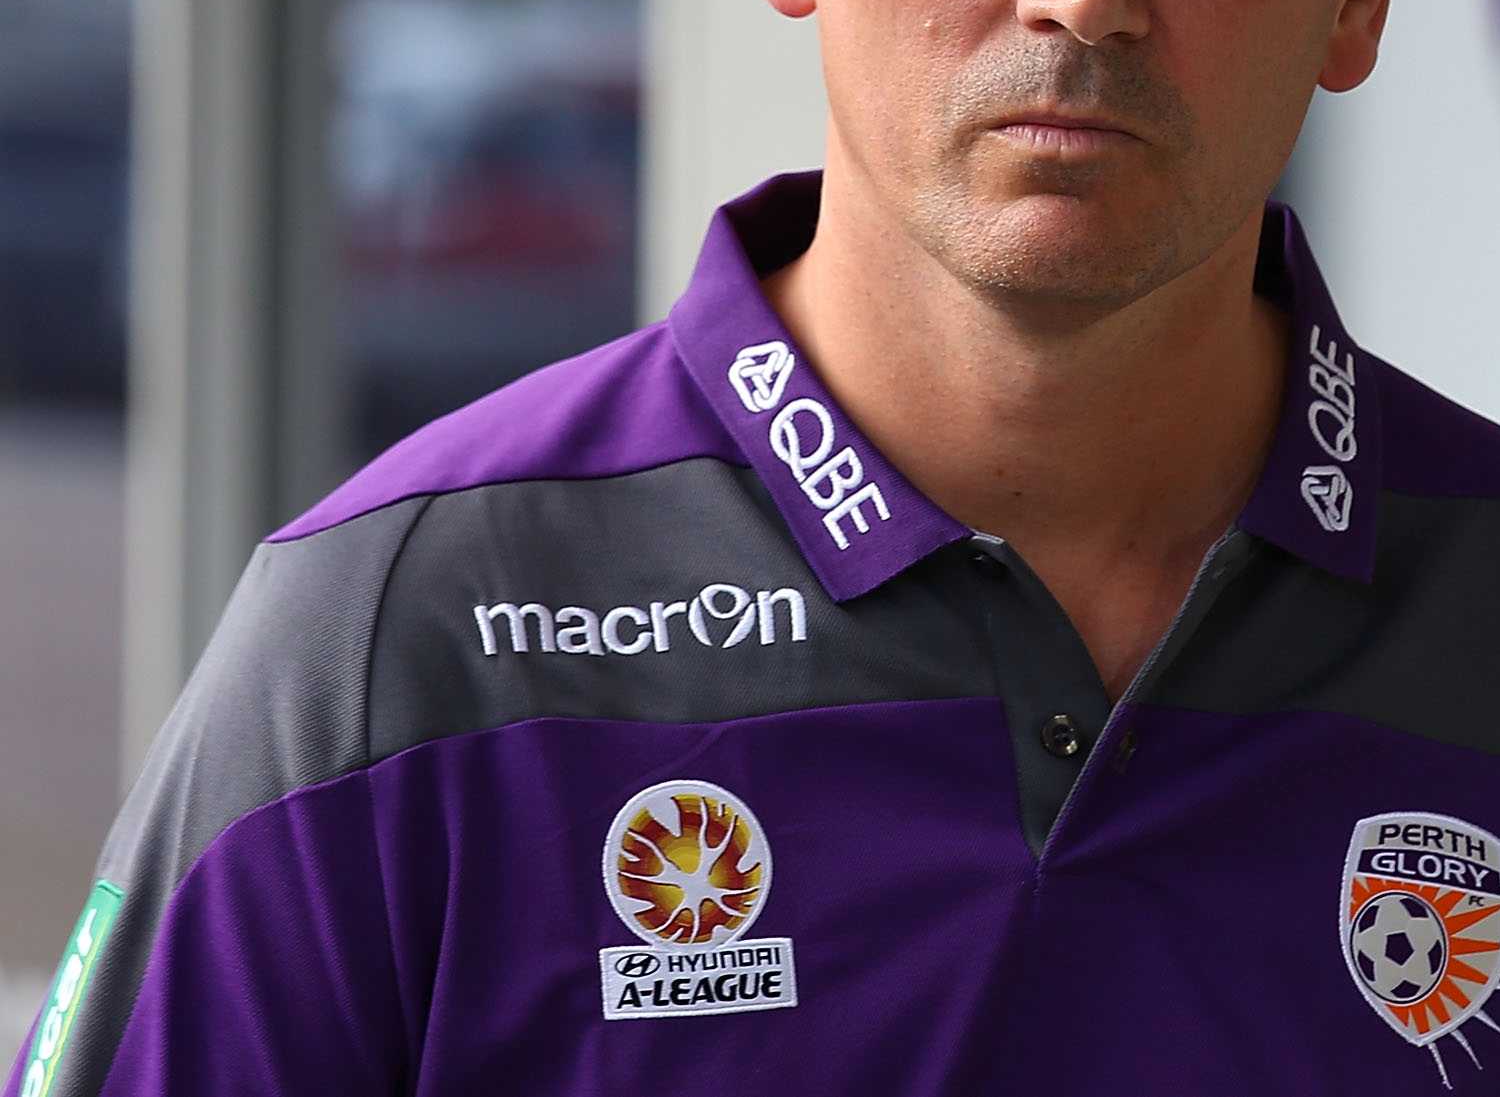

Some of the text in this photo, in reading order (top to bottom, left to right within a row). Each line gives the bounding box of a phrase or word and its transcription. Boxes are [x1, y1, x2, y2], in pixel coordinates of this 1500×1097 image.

[1308, 324, 1358, 461] QBE
[769, 398, 891, 550] QBE
[473, 584, 807, 656] macron
[1378, 824, 1486, 861] PERTH
[1371, 853, 1489, 888] GLORY
[668, 947, 781, 972] HYUNDAI
[617, 971, 782, 1009] A-LEAGUE
